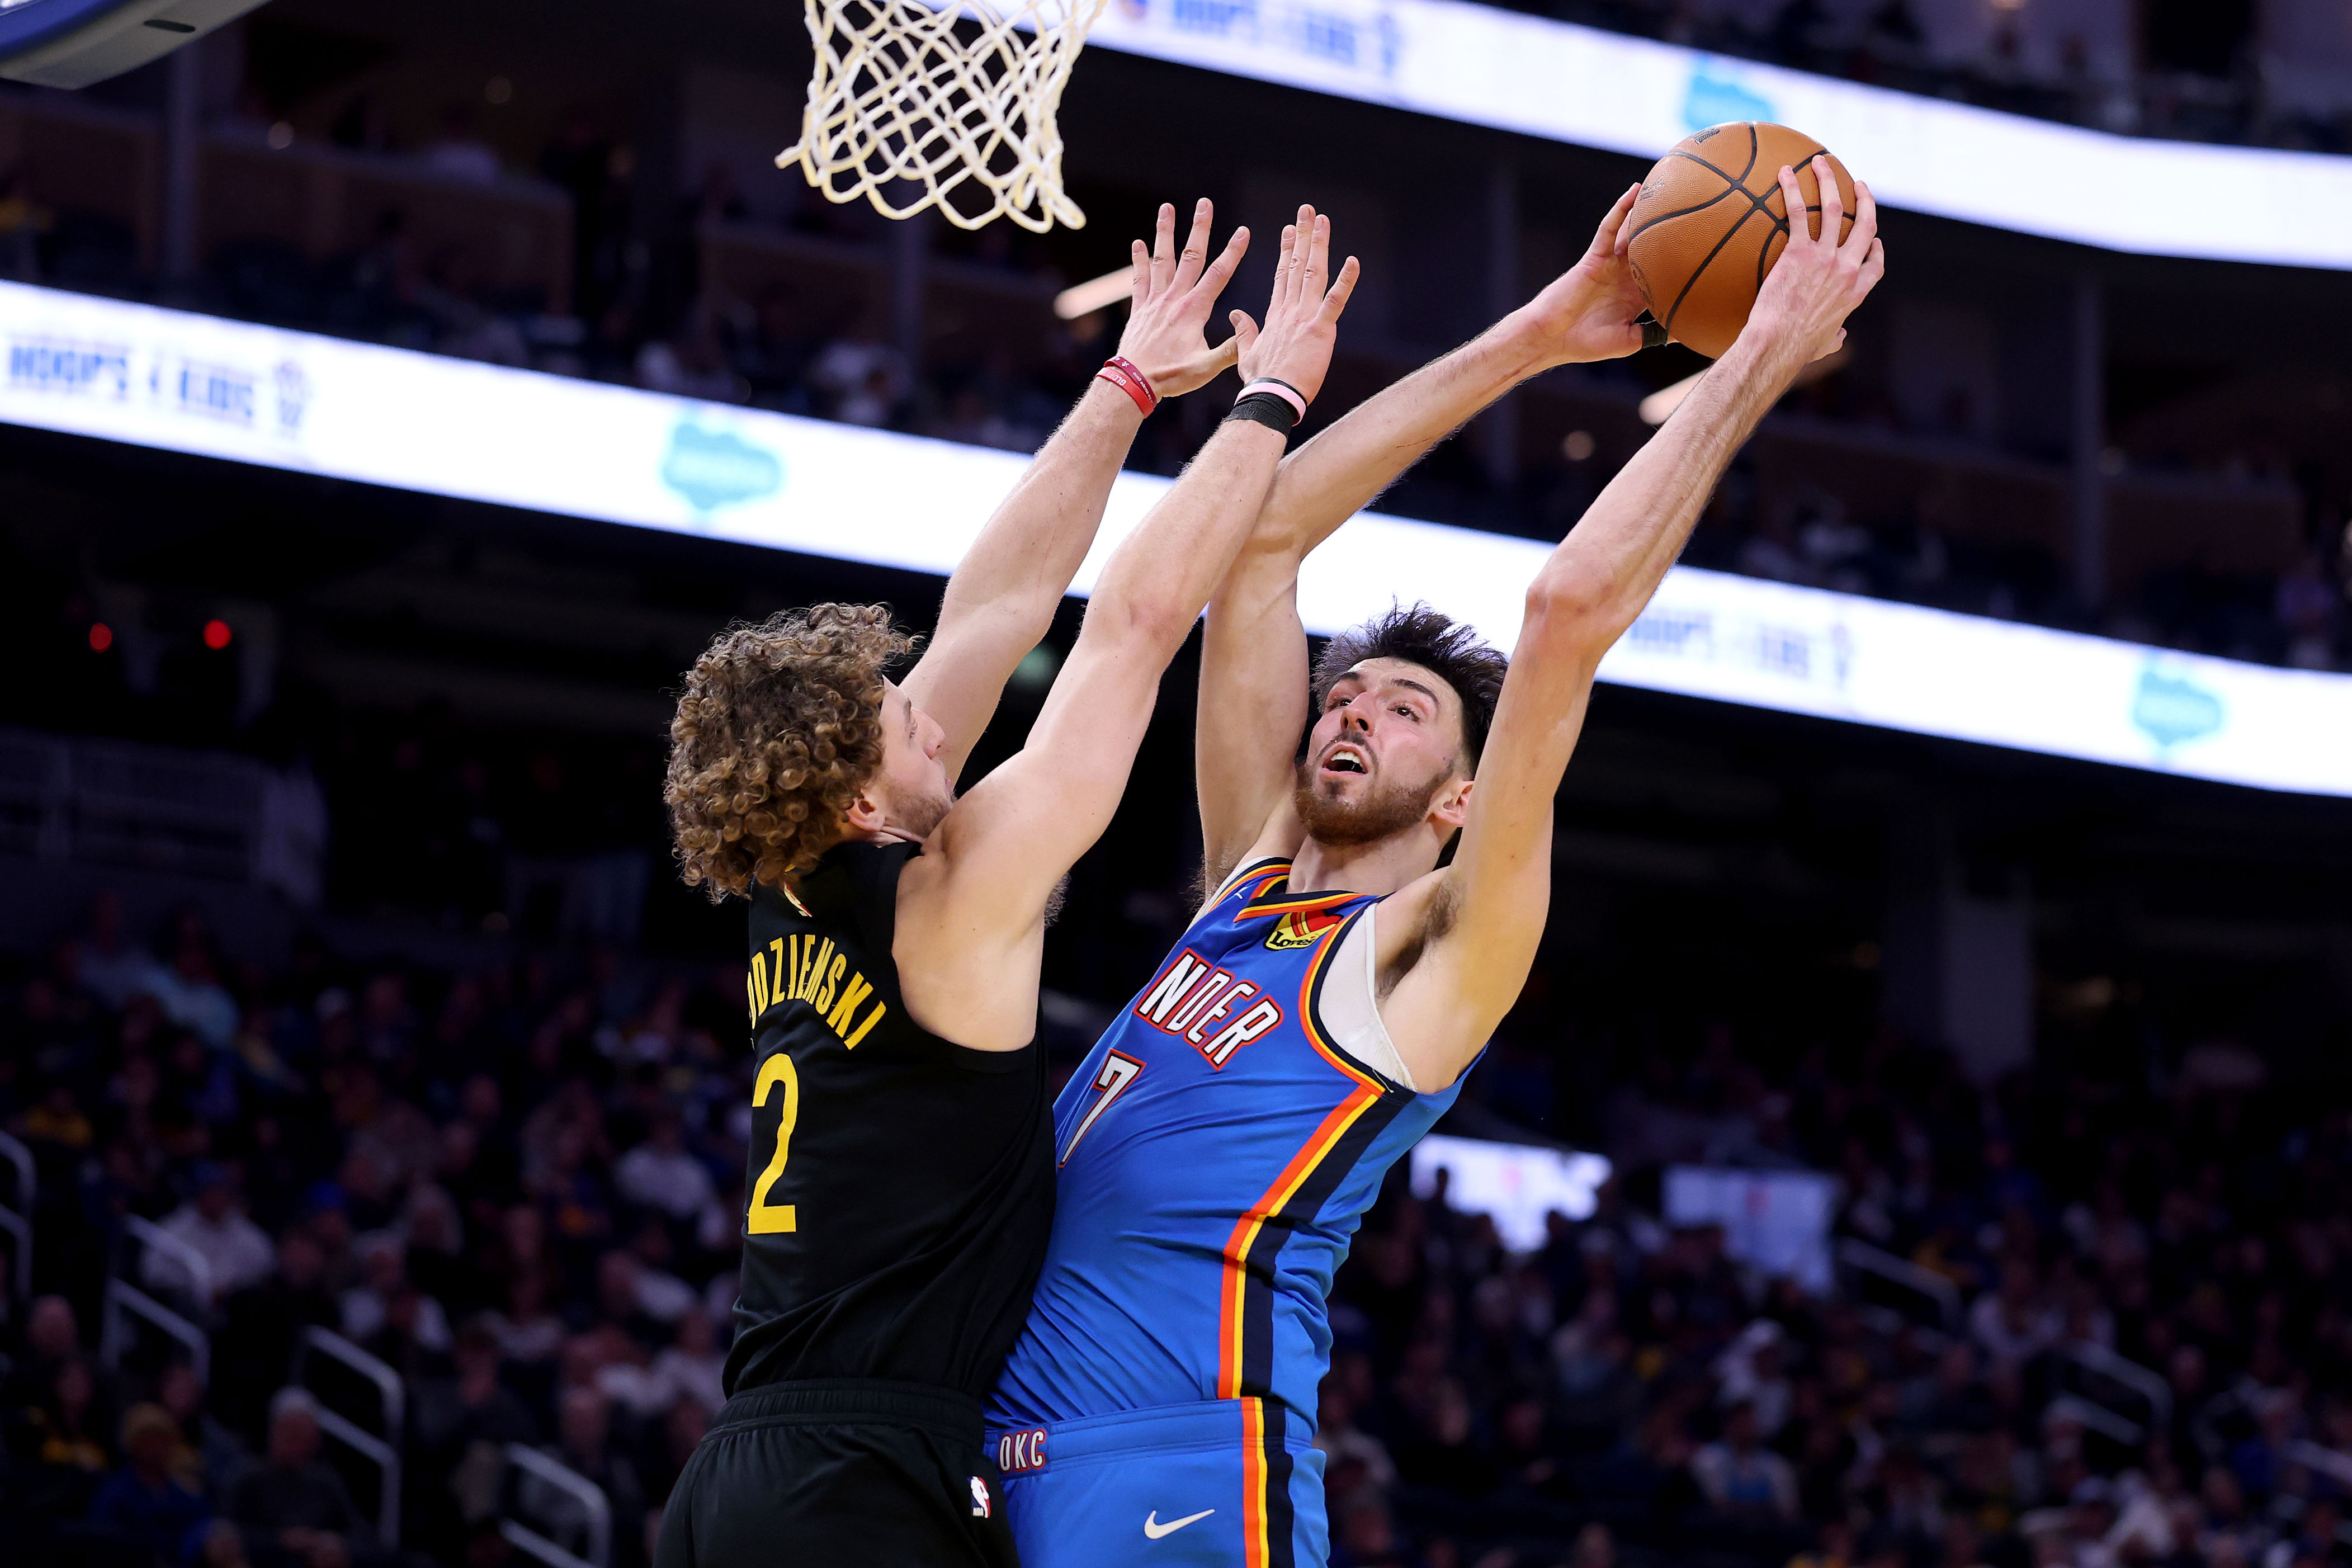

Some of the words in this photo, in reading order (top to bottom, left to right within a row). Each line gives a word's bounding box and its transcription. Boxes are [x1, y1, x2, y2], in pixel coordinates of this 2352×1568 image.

[748, 1053, 799, 1234] 2
[1059, 1049, 1146, 1168] 7
[998, 1429, 1046, 1474] OKC
